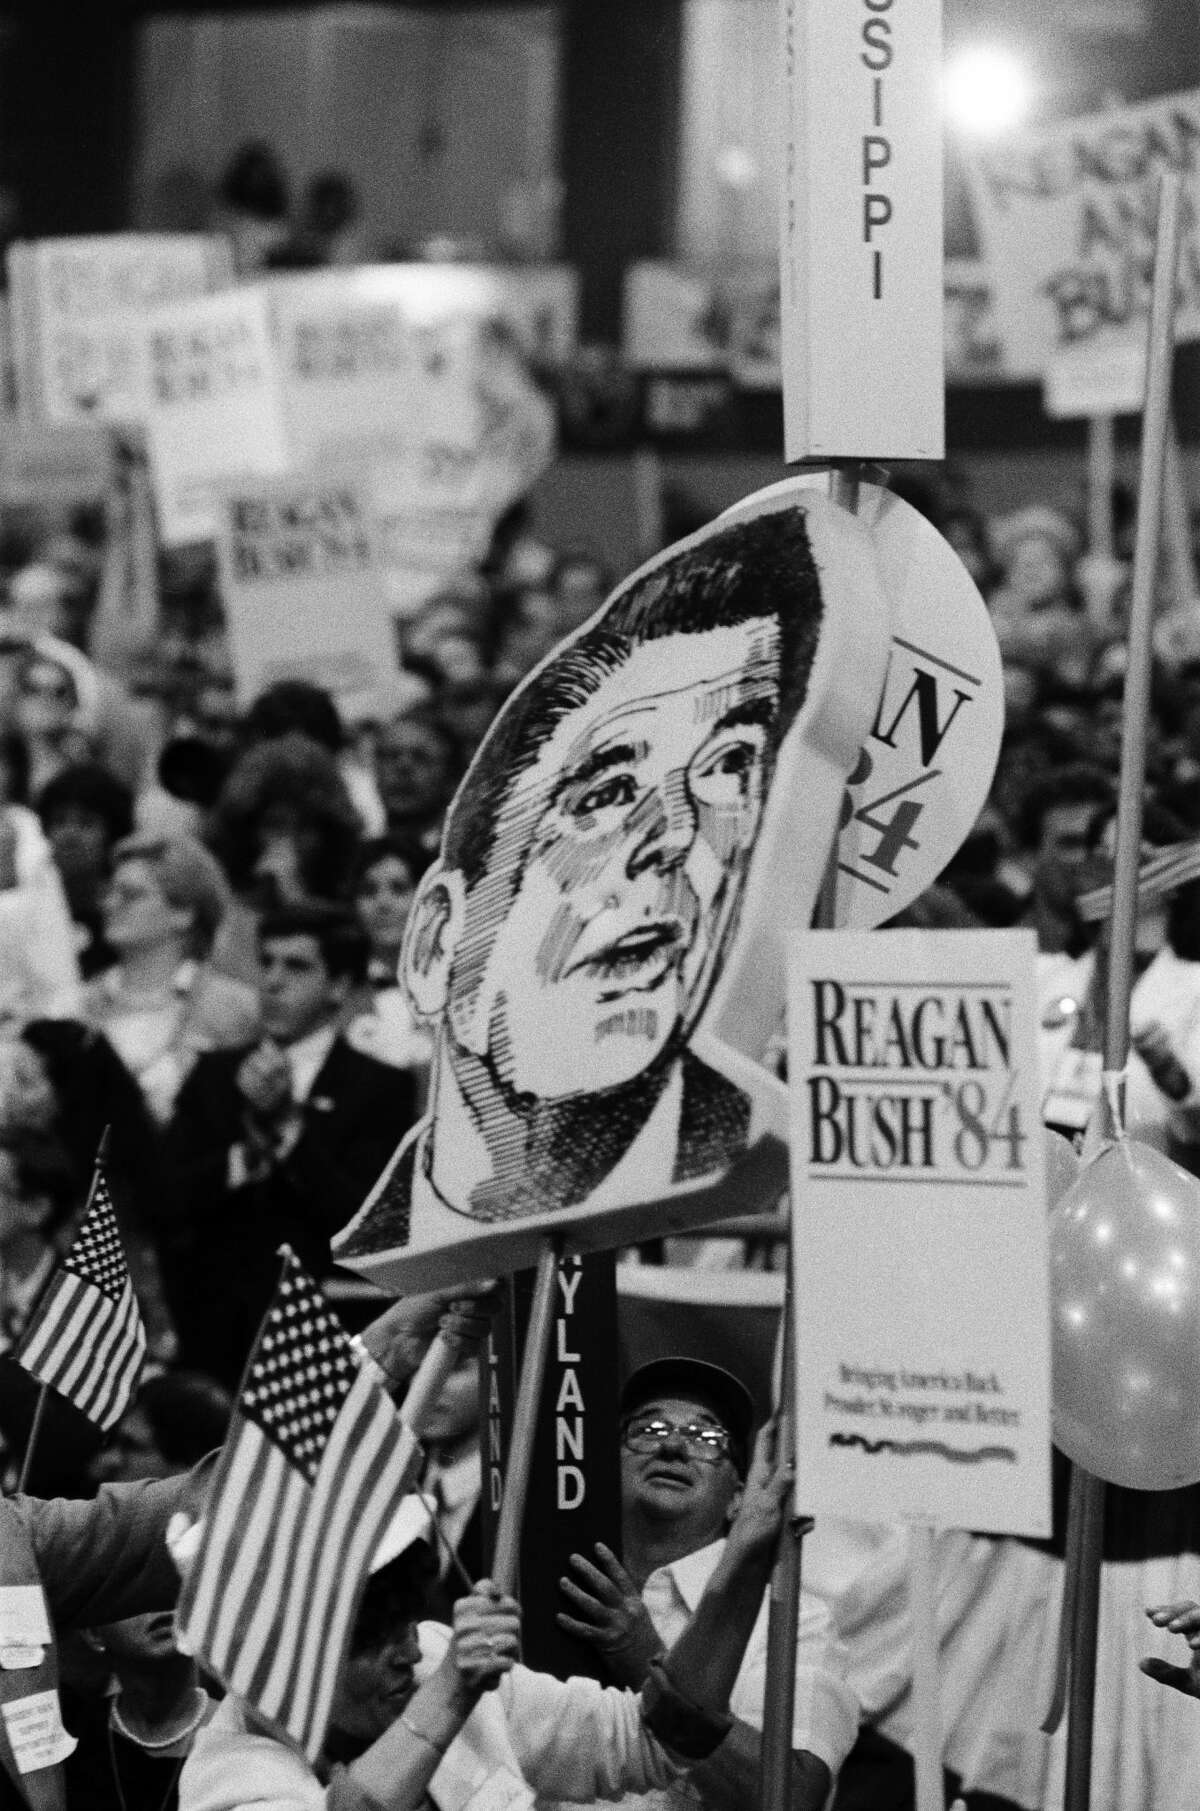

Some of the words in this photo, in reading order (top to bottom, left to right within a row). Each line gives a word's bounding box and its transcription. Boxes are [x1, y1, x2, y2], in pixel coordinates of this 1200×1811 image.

[860, 0, 894, 300] SIPPI
[810, 979, 1012, 1069] REAGAN
[556, 1254, 586, 1510] YLAND
